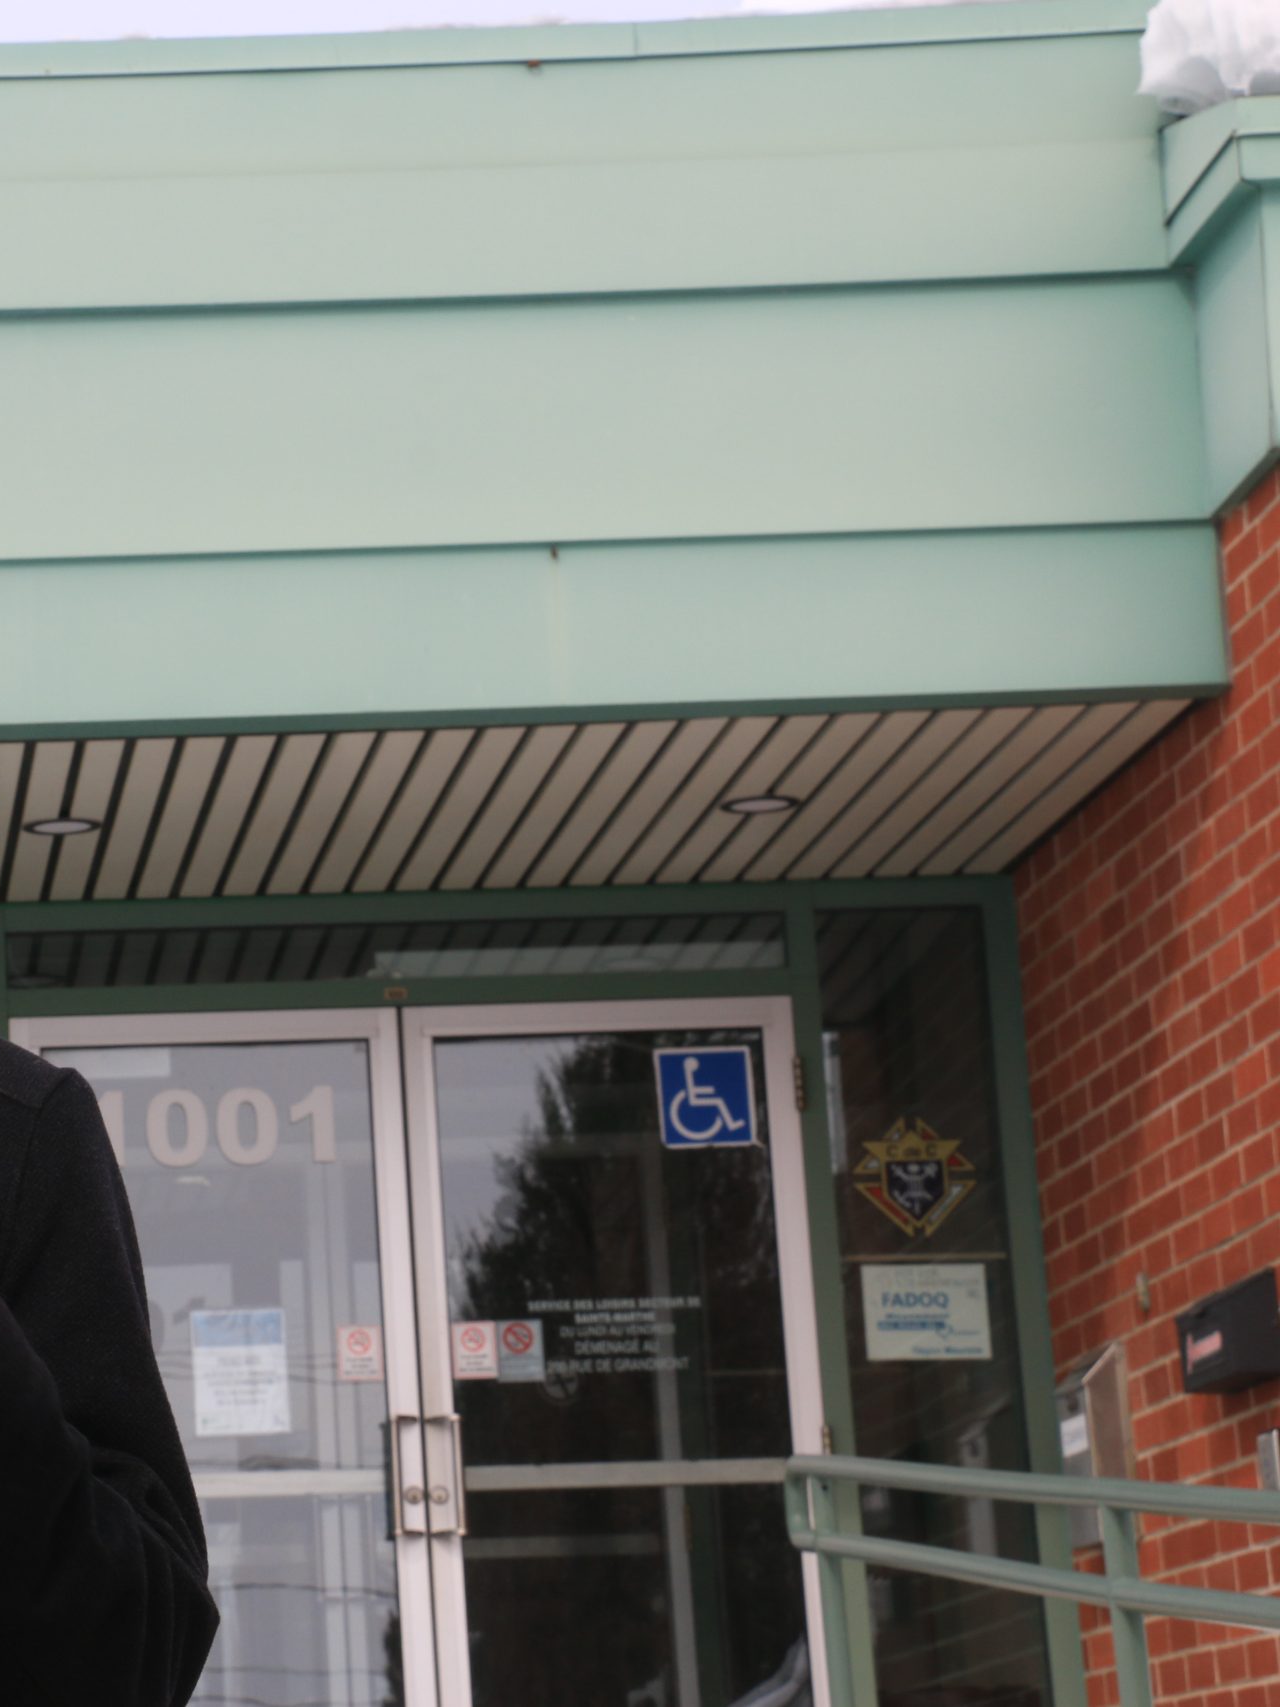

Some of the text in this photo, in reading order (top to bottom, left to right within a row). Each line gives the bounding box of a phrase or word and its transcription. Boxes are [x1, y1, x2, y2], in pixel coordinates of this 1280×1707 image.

[97, 1084, 336, 1168] 1001
[527, 1299, 570, 1312] SERVICE
[881, 1291, 949, 1309] FADOQ
[559, 1323, 675, 1338] DU LUNDI AU VENDREDI
[595, 1358, 612, 1372] DE
